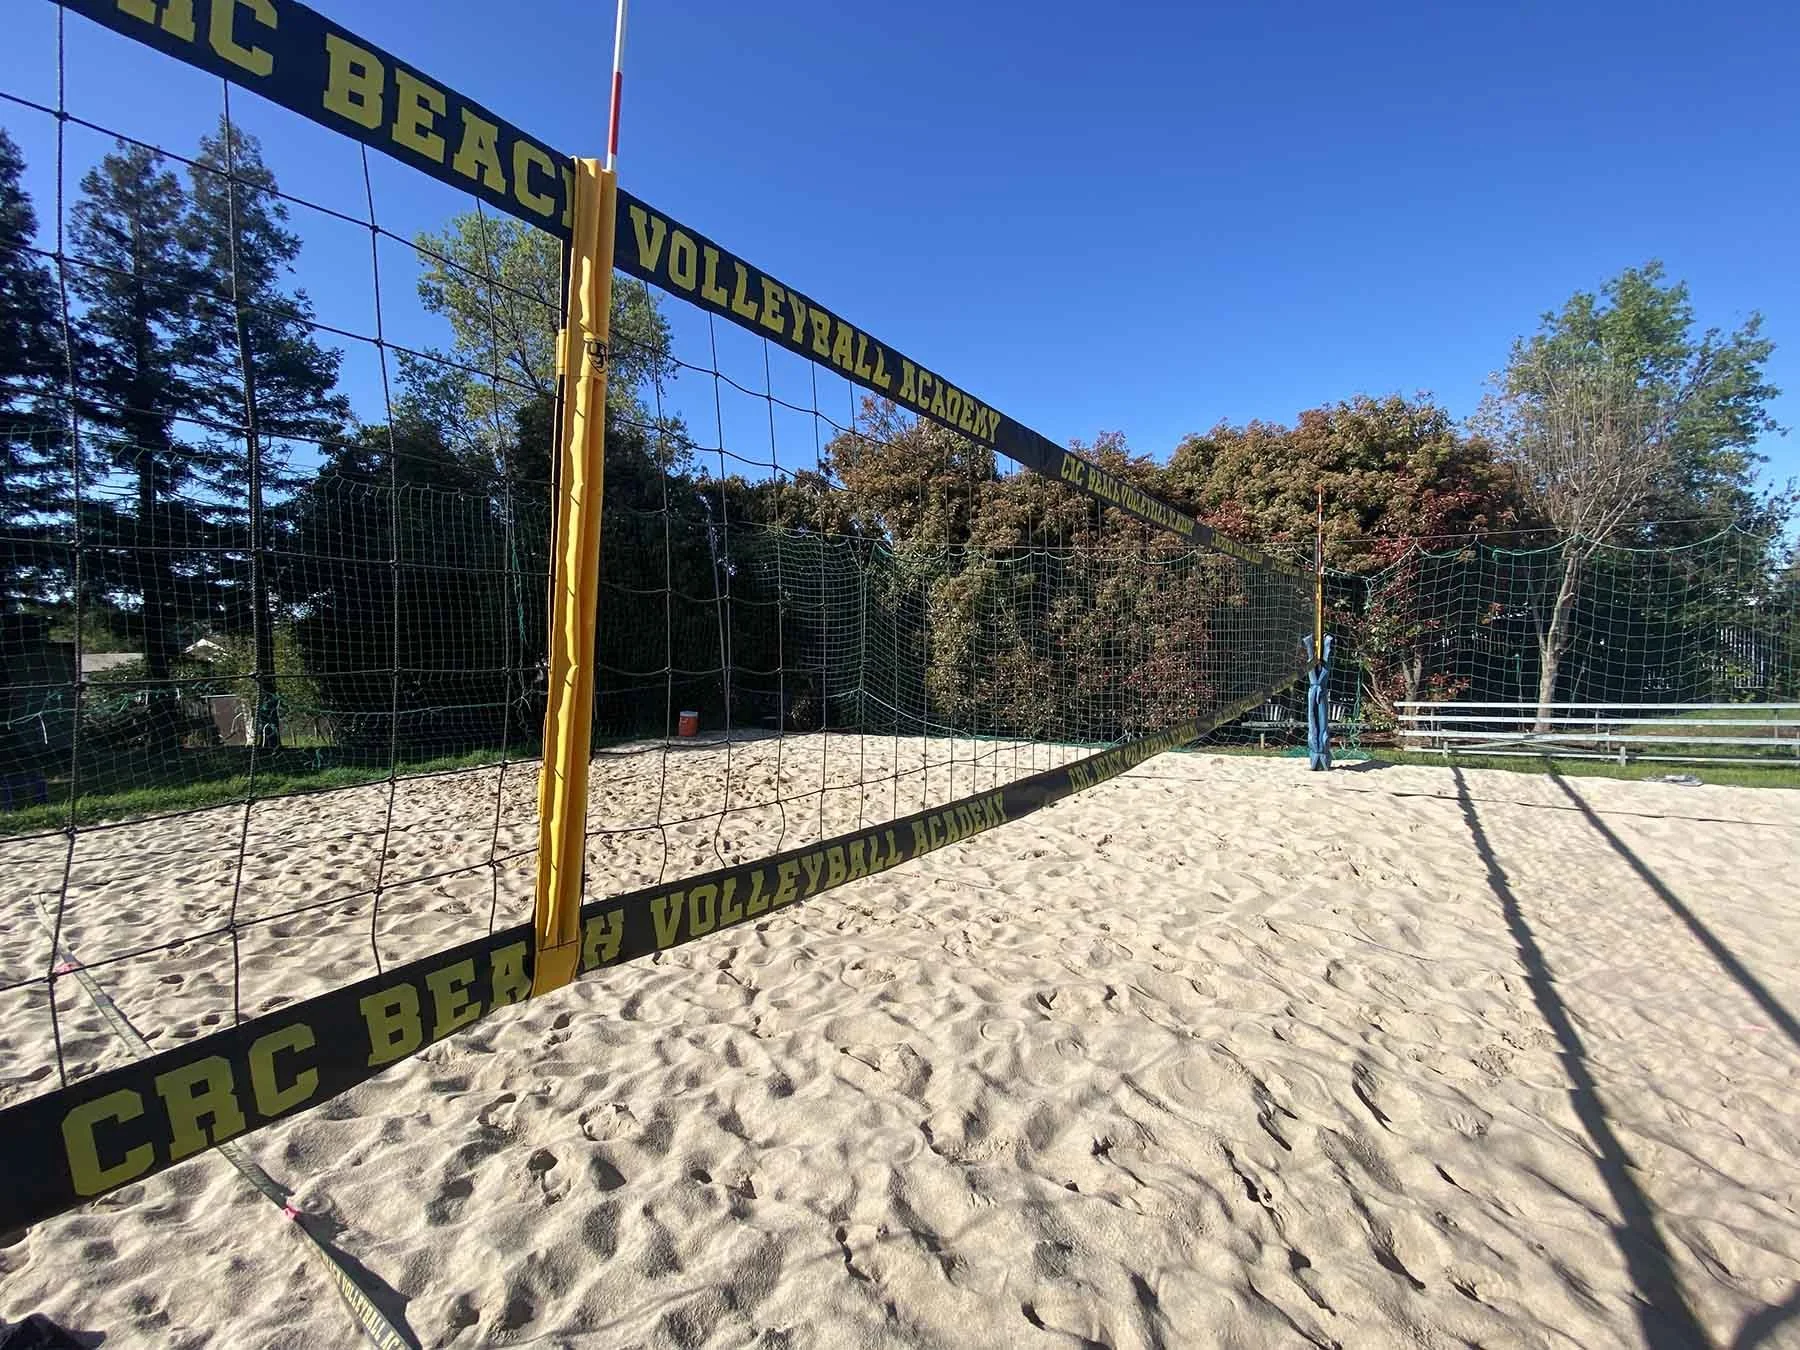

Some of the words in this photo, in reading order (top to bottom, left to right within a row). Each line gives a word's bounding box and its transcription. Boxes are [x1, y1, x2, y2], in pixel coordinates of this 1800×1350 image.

[323, 33, 573, 229] BEAC
[629, 204, 893, 390] VOLLEYBALL
[899, 360, 1001, 443] ACADEMY
[61, 1022, 320, 1196] CRC
[360, 909, 625, 1067] BEAH
[650, 829, 903, 948] VOLLEYBALL
[911, 792, 1007, 858] ACADEMY
